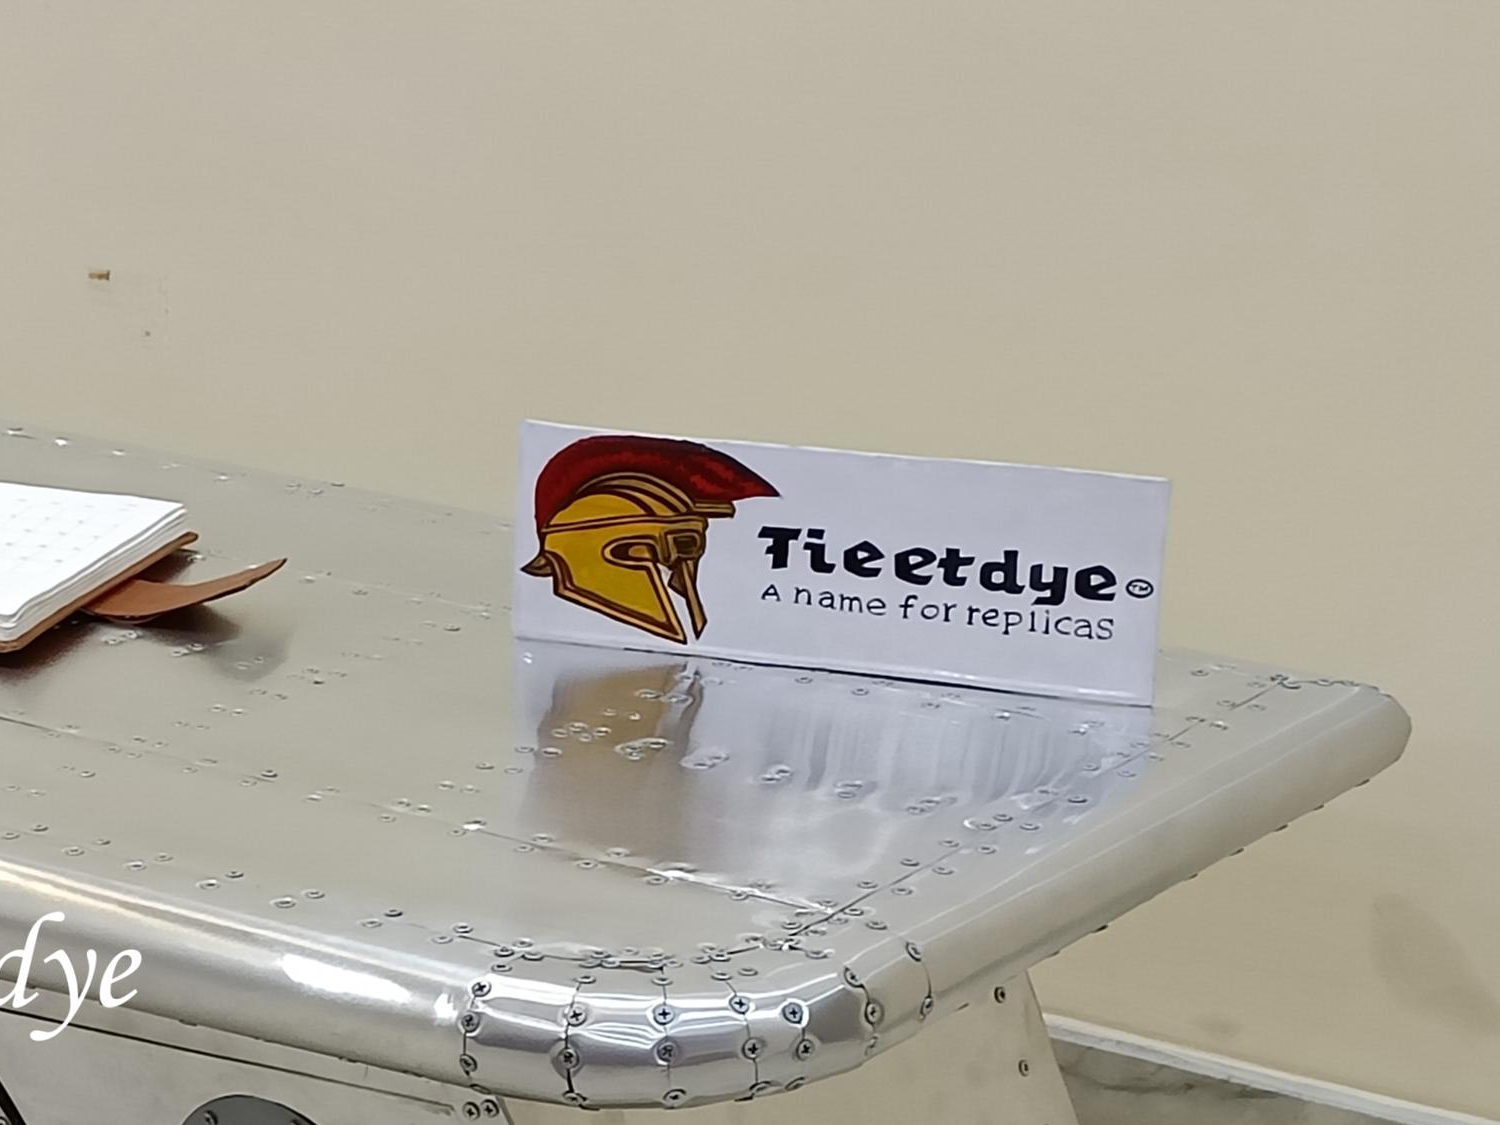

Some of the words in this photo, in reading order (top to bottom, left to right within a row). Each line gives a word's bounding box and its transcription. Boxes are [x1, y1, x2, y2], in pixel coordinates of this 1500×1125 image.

[757, 525, 1117, 606] Tieetdye
[761, 584, 781, 602] A
[794, 586, 887, 616] name
[898, 594, 957, 622] for
[966, 605, 1115, 640] replicas
